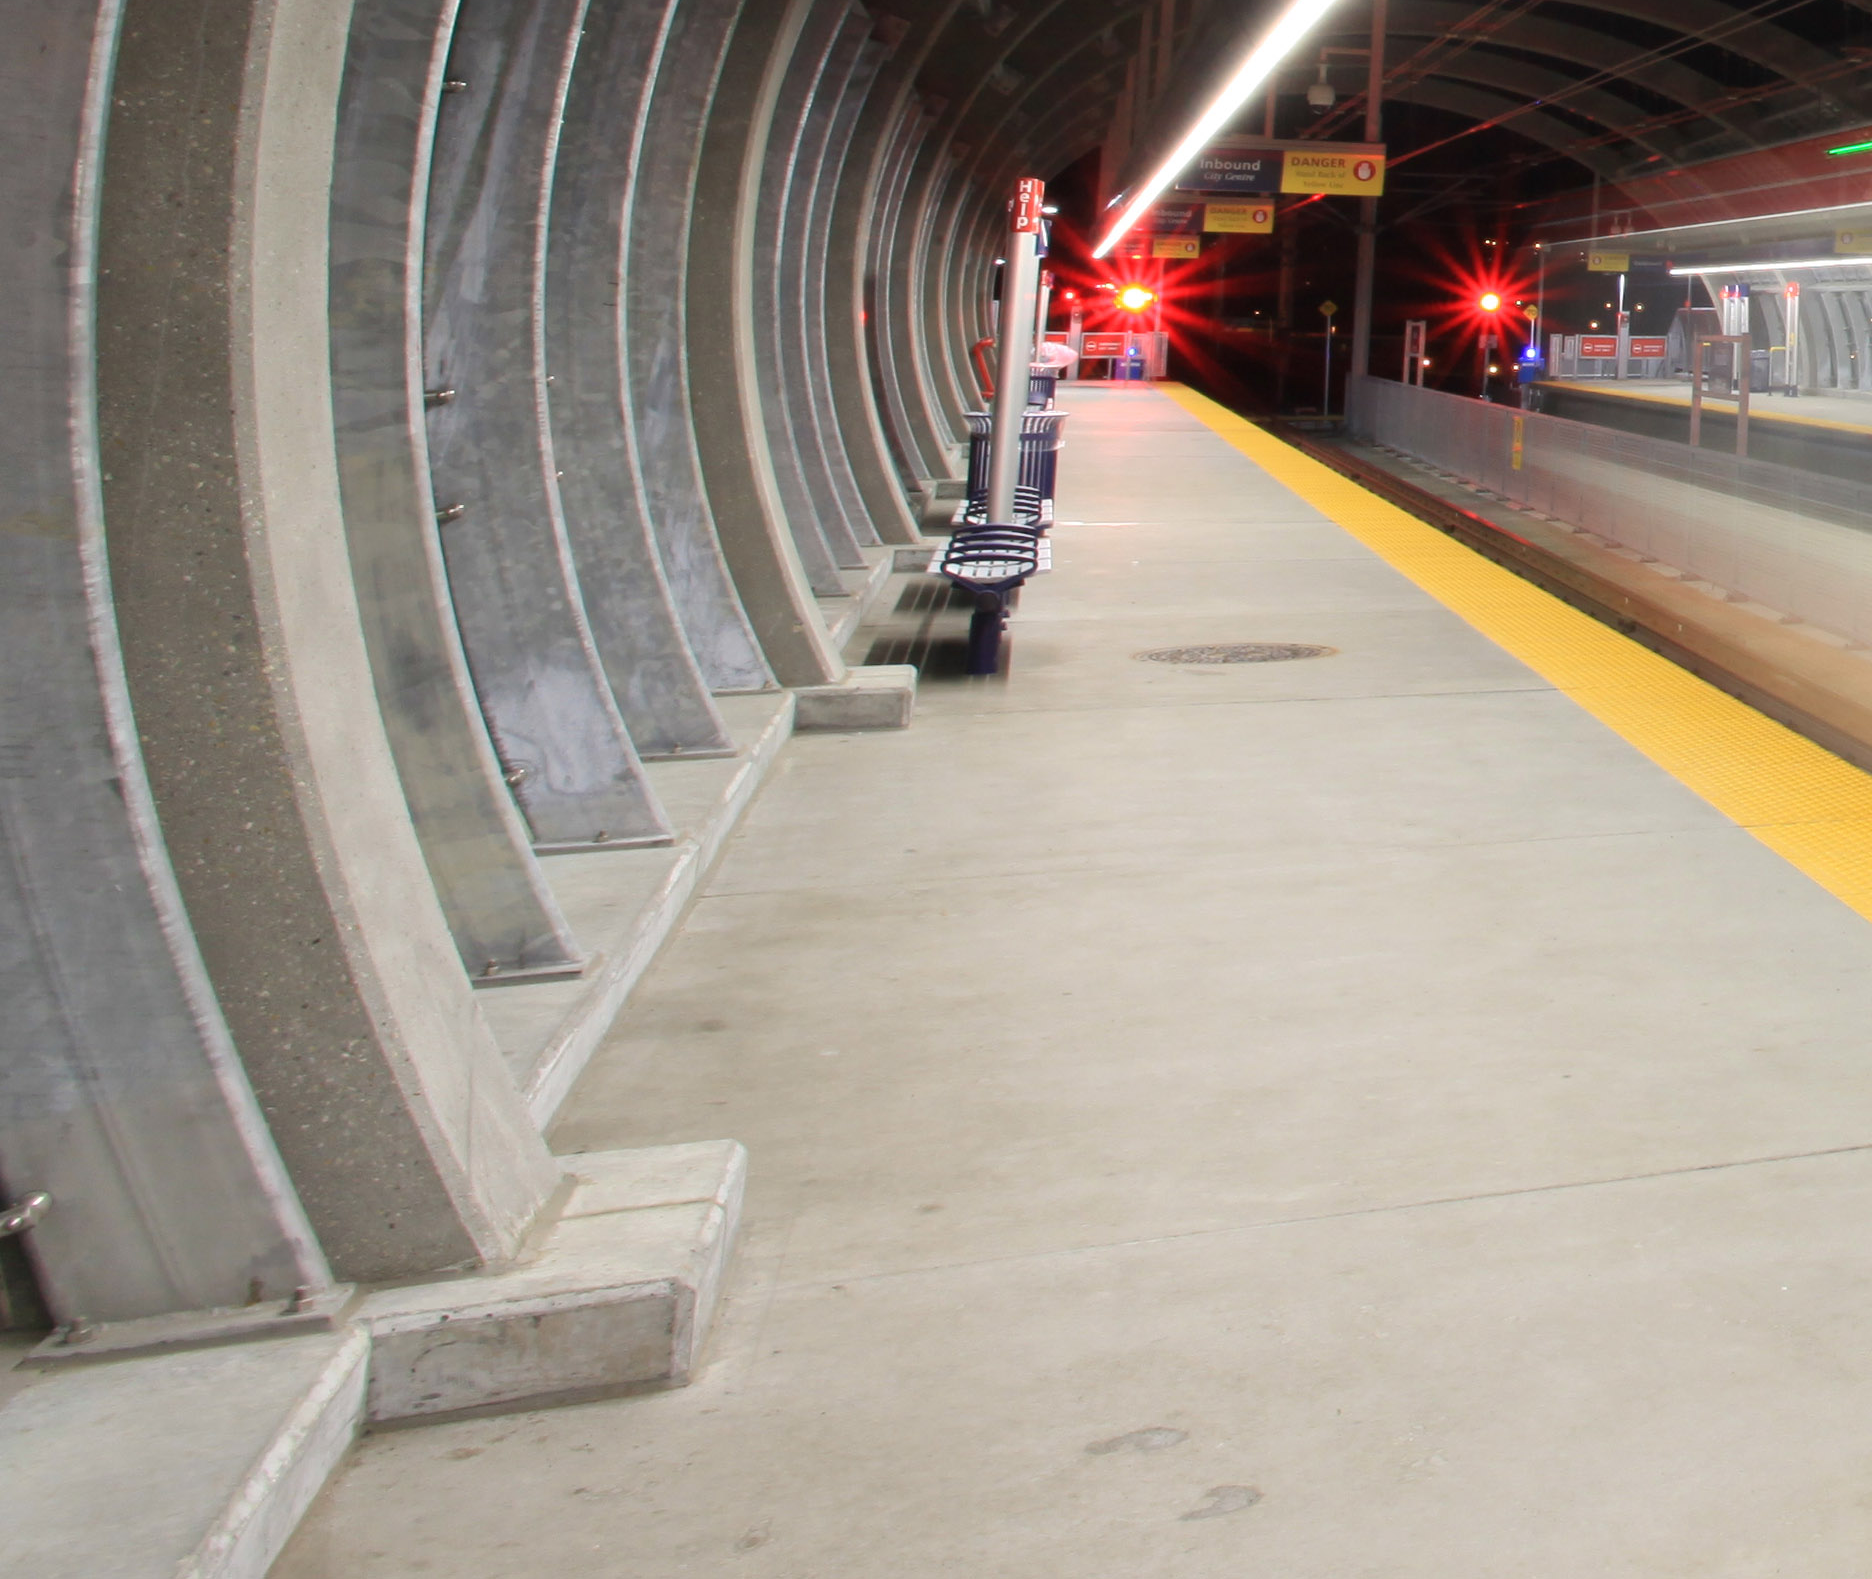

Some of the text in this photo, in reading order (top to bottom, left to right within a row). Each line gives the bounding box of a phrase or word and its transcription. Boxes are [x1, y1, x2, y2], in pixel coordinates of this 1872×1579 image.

[1200, 158, 1261, 171] Inbound
[1291, 156, 1346, 168] DANGER
[1016, 180, 1033, 230] Help
